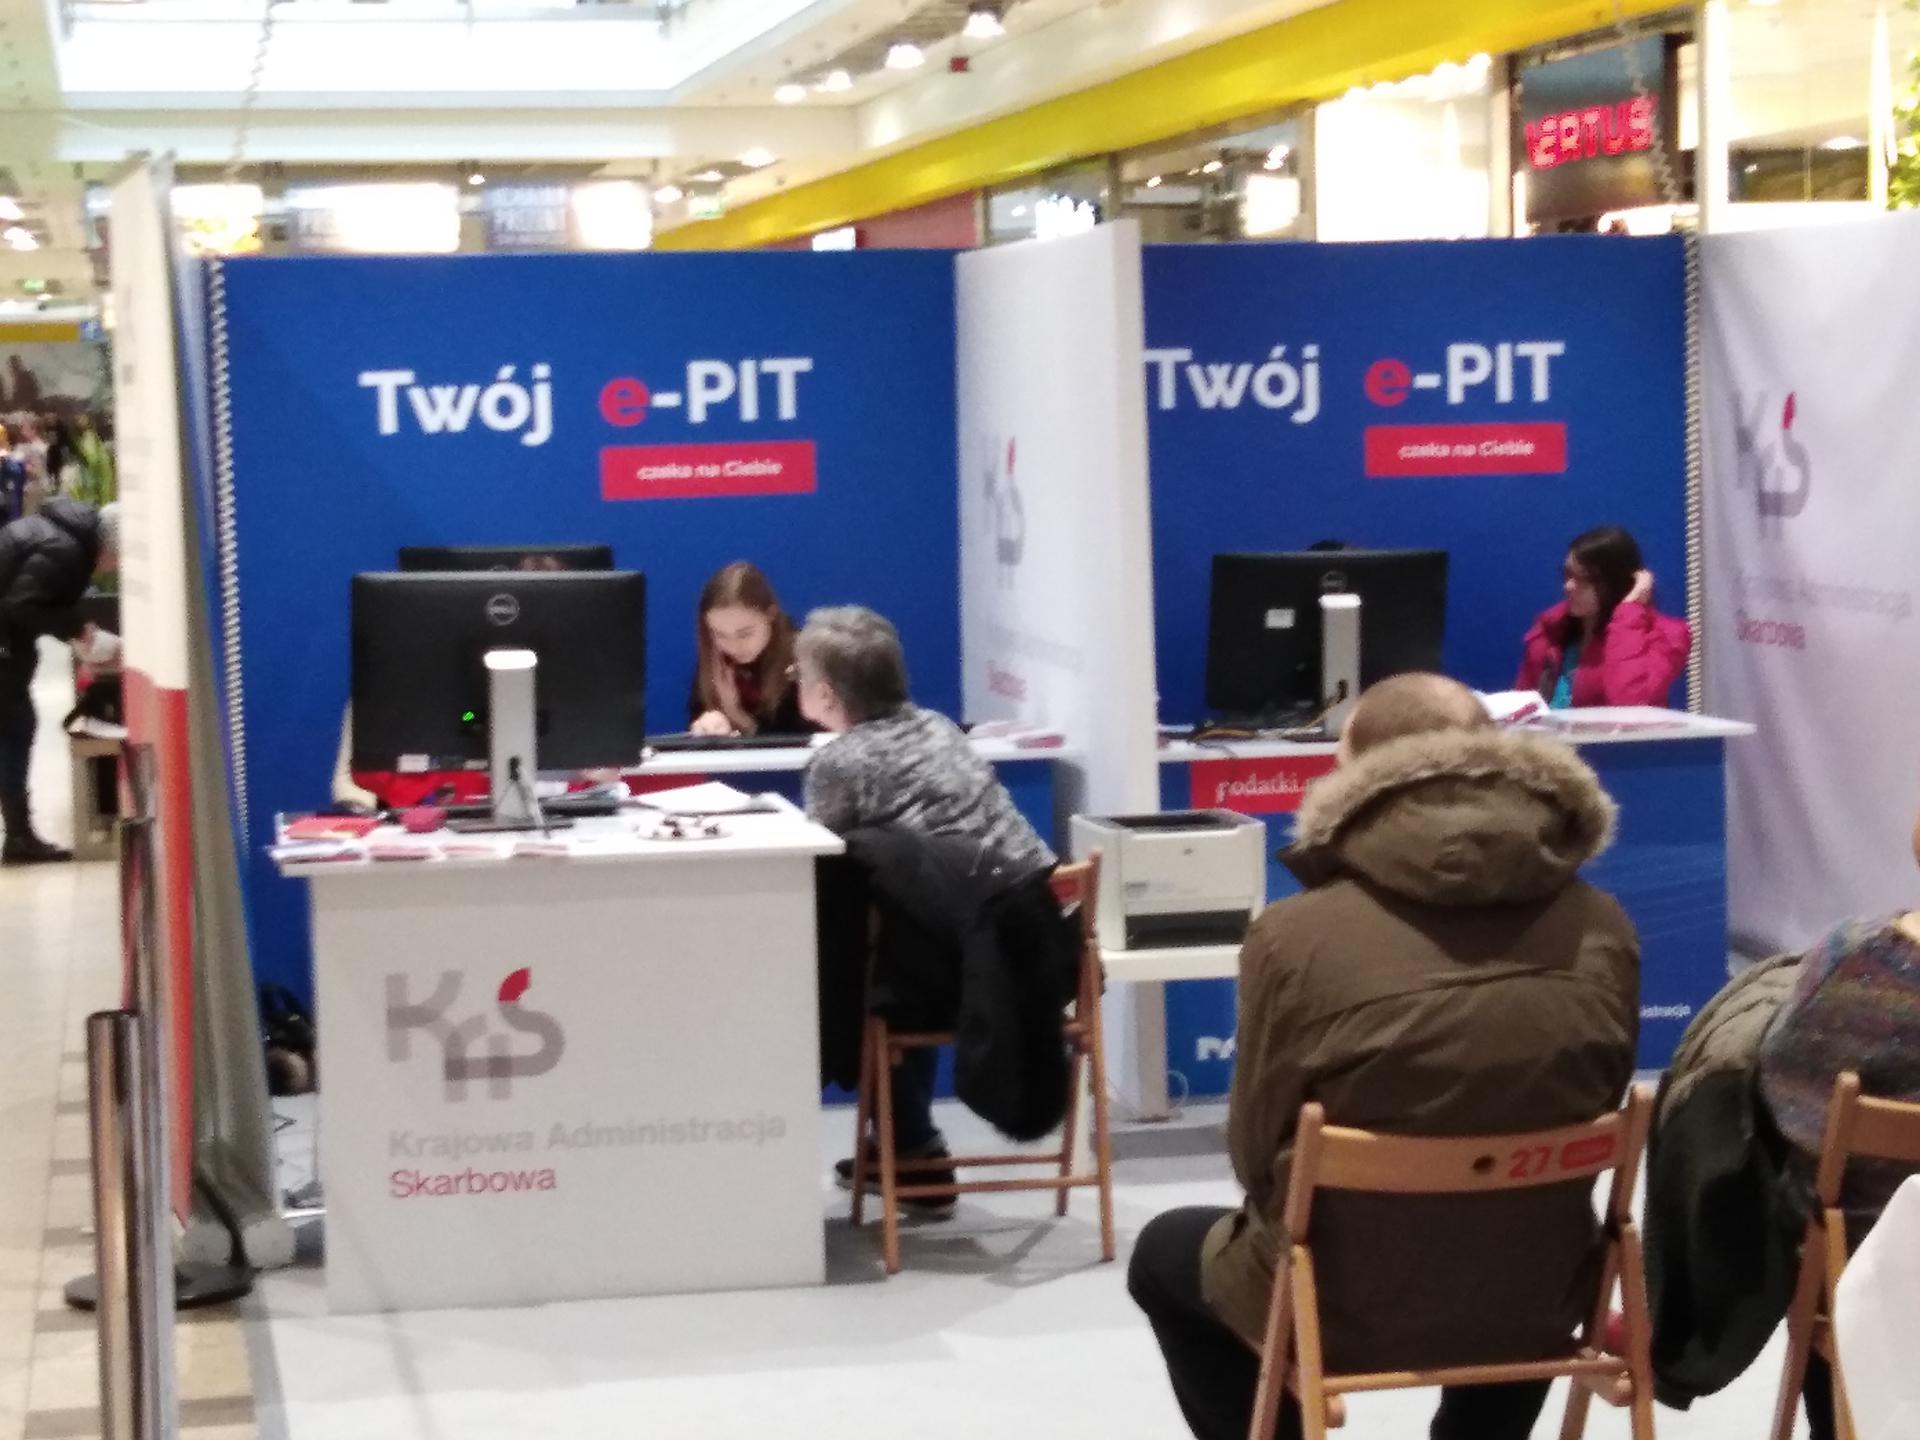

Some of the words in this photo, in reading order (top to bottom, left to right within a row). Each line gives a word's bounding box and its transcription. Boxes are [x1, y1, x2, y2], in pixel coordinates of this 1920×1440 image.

[357, 362, 554, 447] Twój
[599, 356, 814, 428] e-PIT
[1142, 343, 1322, 425] Twój
[1364, 340, 1566, 407] e-PIT
[389, 1129, 535, 1161] Krajowa
[546, 1111, 787, 1150] Administracja
[390, 1167, 558, 1199] Skarbowa
[1509, 1146, 1552, 1178] 27
